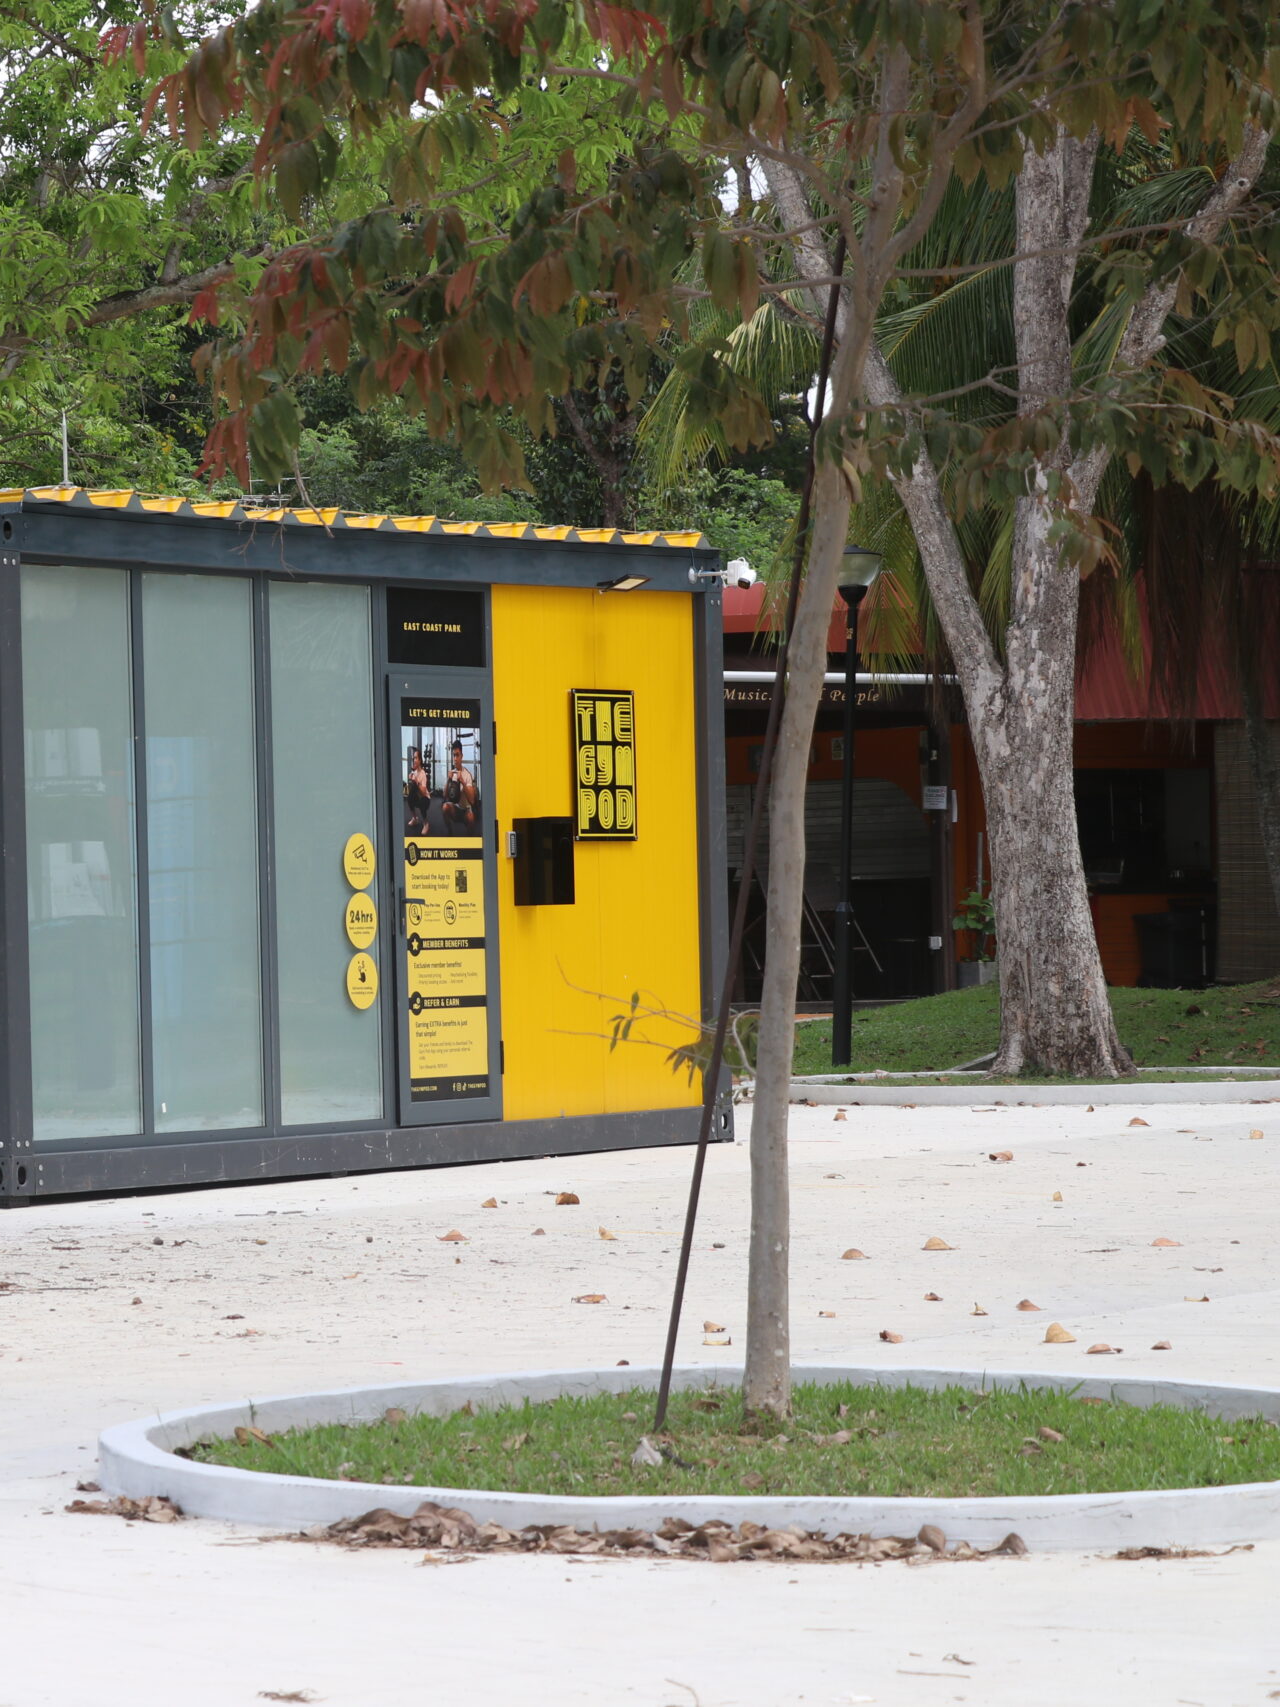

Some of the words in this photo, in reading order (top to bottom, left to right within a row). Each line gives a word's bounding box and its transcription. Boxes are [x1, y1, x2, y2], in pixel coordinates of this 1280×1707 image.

[403, 622, 420, 631] EAST
[422, 623, 442, 632] COAST
[444, 624, 461, 633] PARK
[830, 689, 880, 706] Peple
[409, 708, 427, 718] LET'S
[429, 709, 440, 718] GET
[443, 710, 470, 719] STARTED
[580, 789, 633, 830] POD
[420, 850, 433, 858] HOW
[433, 850, 438, 858] IT
[440, 850, 458, 858] WORKS
[422, 940, 444, 948] MEMBER
[444, 940, 468, 948] BENEFITS
[423, 999, 440, 1007] REFER
[446, 998, 460, 1006] EARN
